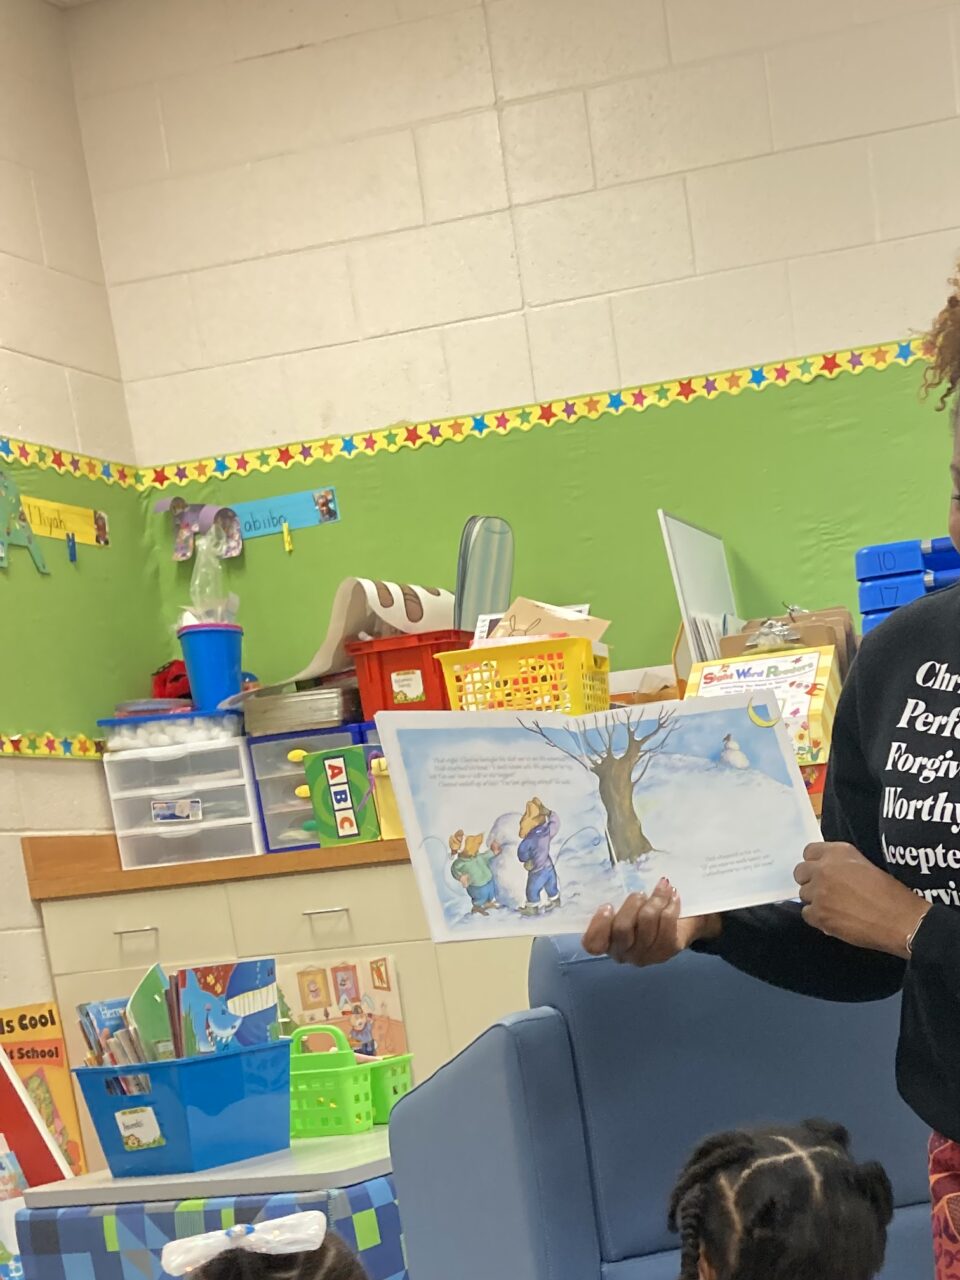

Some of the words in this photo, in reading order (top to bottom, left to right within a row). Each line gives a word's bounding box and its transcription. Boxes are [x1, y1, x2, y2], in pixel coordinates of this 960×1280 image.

[878, 551, 896, 571] 10
[880, 586, 899, 606] 17
[736, 667, 764, 679] Word
[18, 1009, 57, 1031] Cool
[17, 1046, 59, 1060] School
